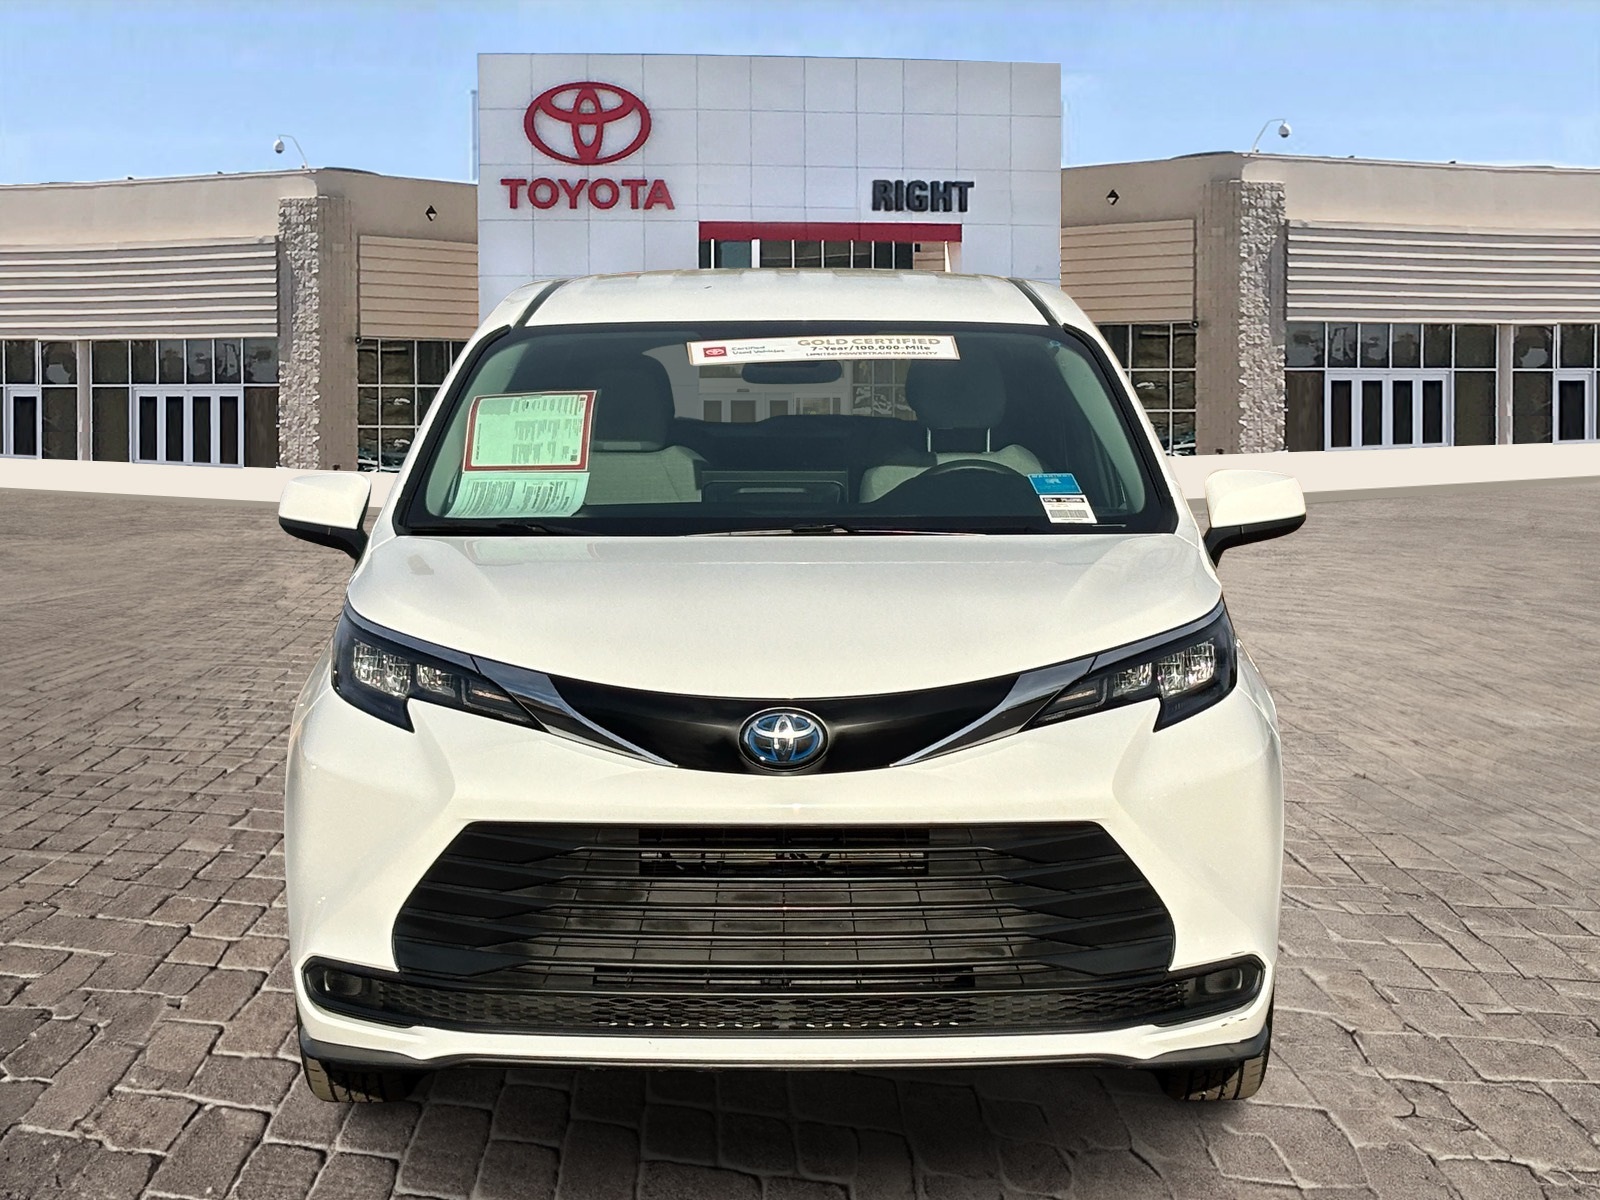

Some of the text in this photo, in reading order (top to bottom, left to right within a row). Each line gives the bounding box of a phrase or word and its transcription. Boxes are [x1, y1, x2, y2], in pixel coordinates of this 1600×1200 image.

[500, 177, 675, 210] TOYOTA
[872, 179, 975, 212] RIGHT
[797, 338, 849, 346] GOLD
